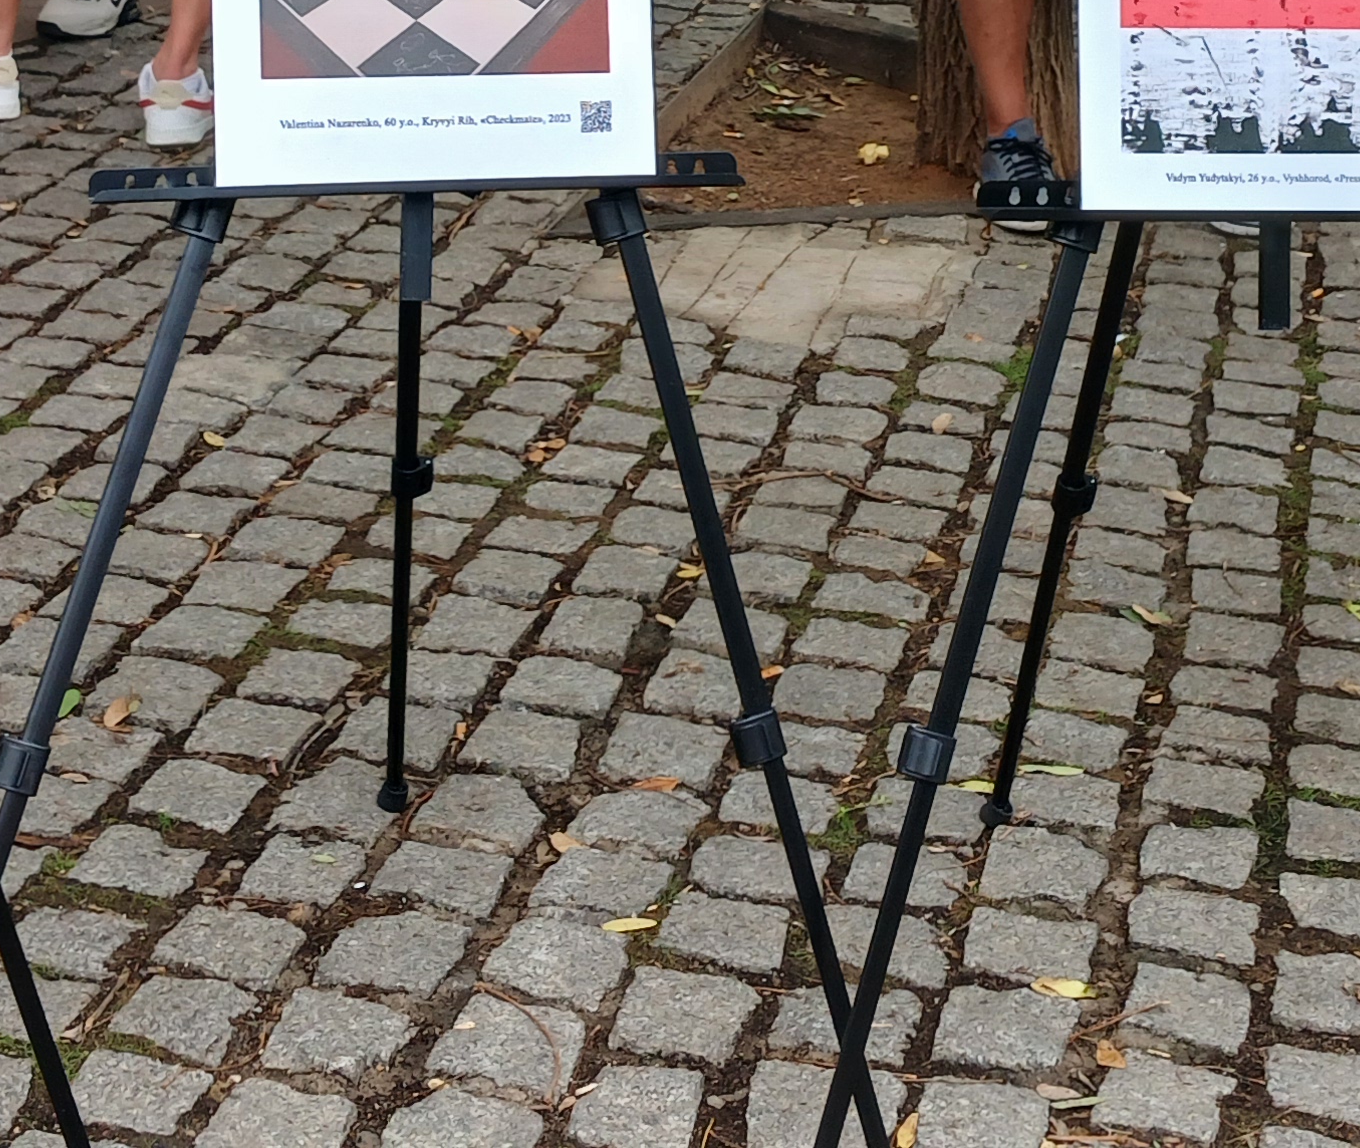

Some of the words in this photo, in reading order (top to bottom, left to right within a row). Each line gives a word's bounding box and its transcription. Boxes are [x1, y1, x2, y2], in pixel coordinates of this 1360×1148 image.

[279, 118, 325, 129] Valentina
[384, 117, 396, 127] 60
[458, 115, 478, 126] Rih,
[548, 113, 571, 123] 2023
[1166, 171, 1196, 184] Vadym
[1247, 173, 1259, 182] 26
